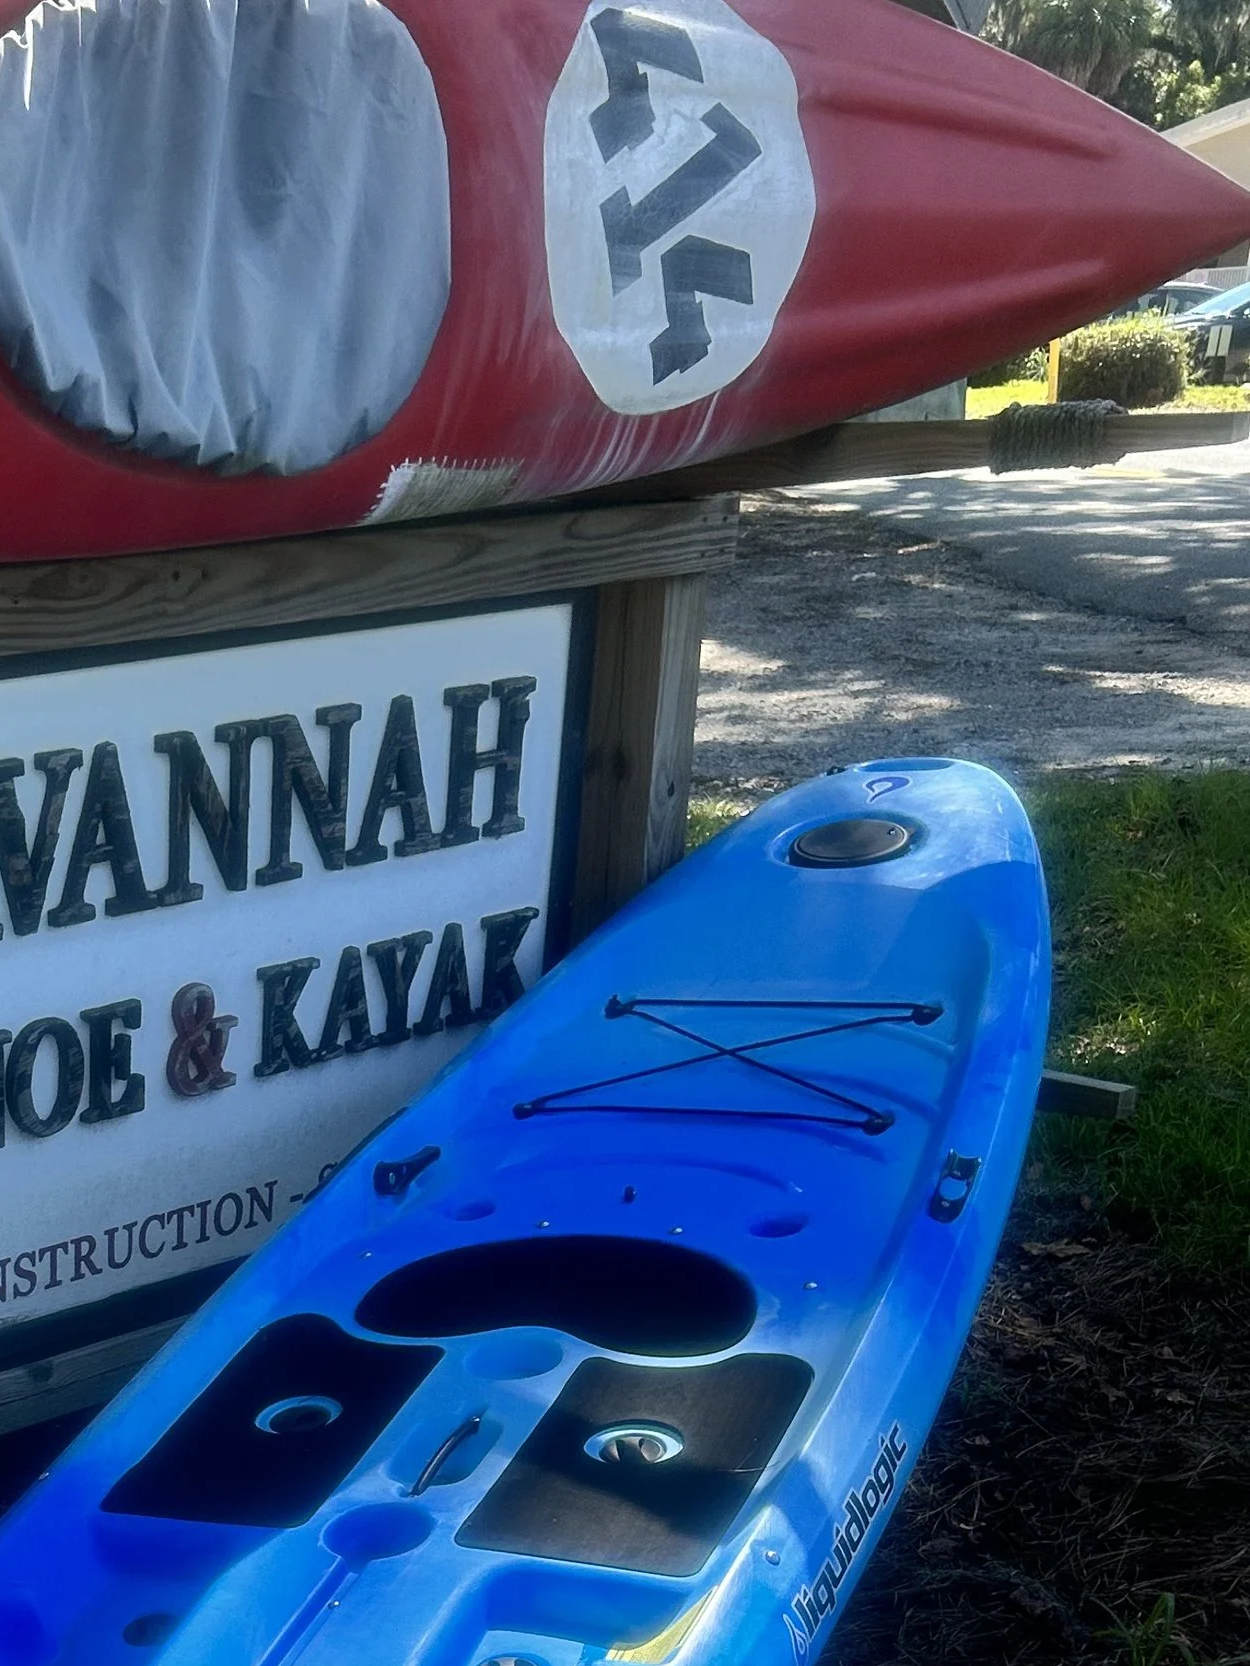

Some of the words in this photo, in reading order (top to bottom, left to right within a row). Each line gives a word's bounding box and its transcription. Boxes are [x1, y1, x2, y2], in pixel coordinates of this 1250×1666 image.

[165, 982, 238, 1097] &
[253, 907, 539, 1078] KAYAK
[791, 1420, 907, 1642] liquidlogic
